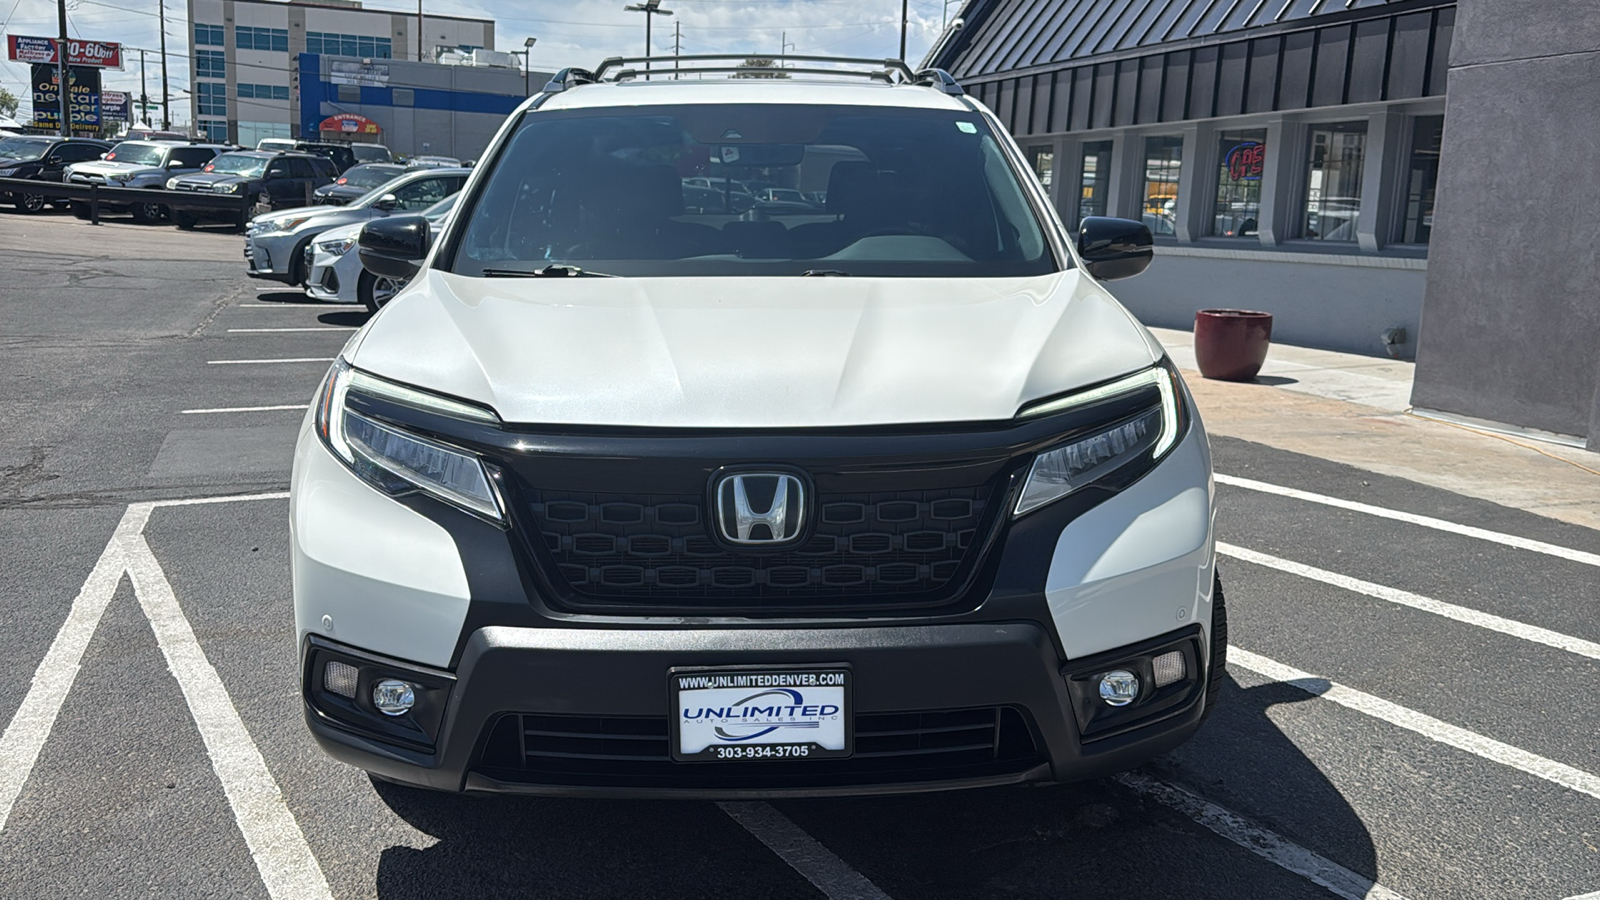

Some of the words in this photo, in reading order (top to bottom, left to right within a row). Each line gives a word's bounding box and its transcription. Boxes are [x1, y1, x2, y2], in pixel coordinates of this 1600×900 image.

[17, 37, 49, 46] APPLIANCE
[39, 83, 58, 91] On
[69, 85, 90, 93] ale
[334, 114, 366, 122] ENTRANCE
[70, 122, 99, 131] Delivery
[1230, 145, 1265, 180] OPE
[679, 674, 844, 688] WWWUNLIMITEDDENVER.COM
[683, 705, 839, 719] UNLIMITED
[717, 745, 809, 758] 303-934-3705
